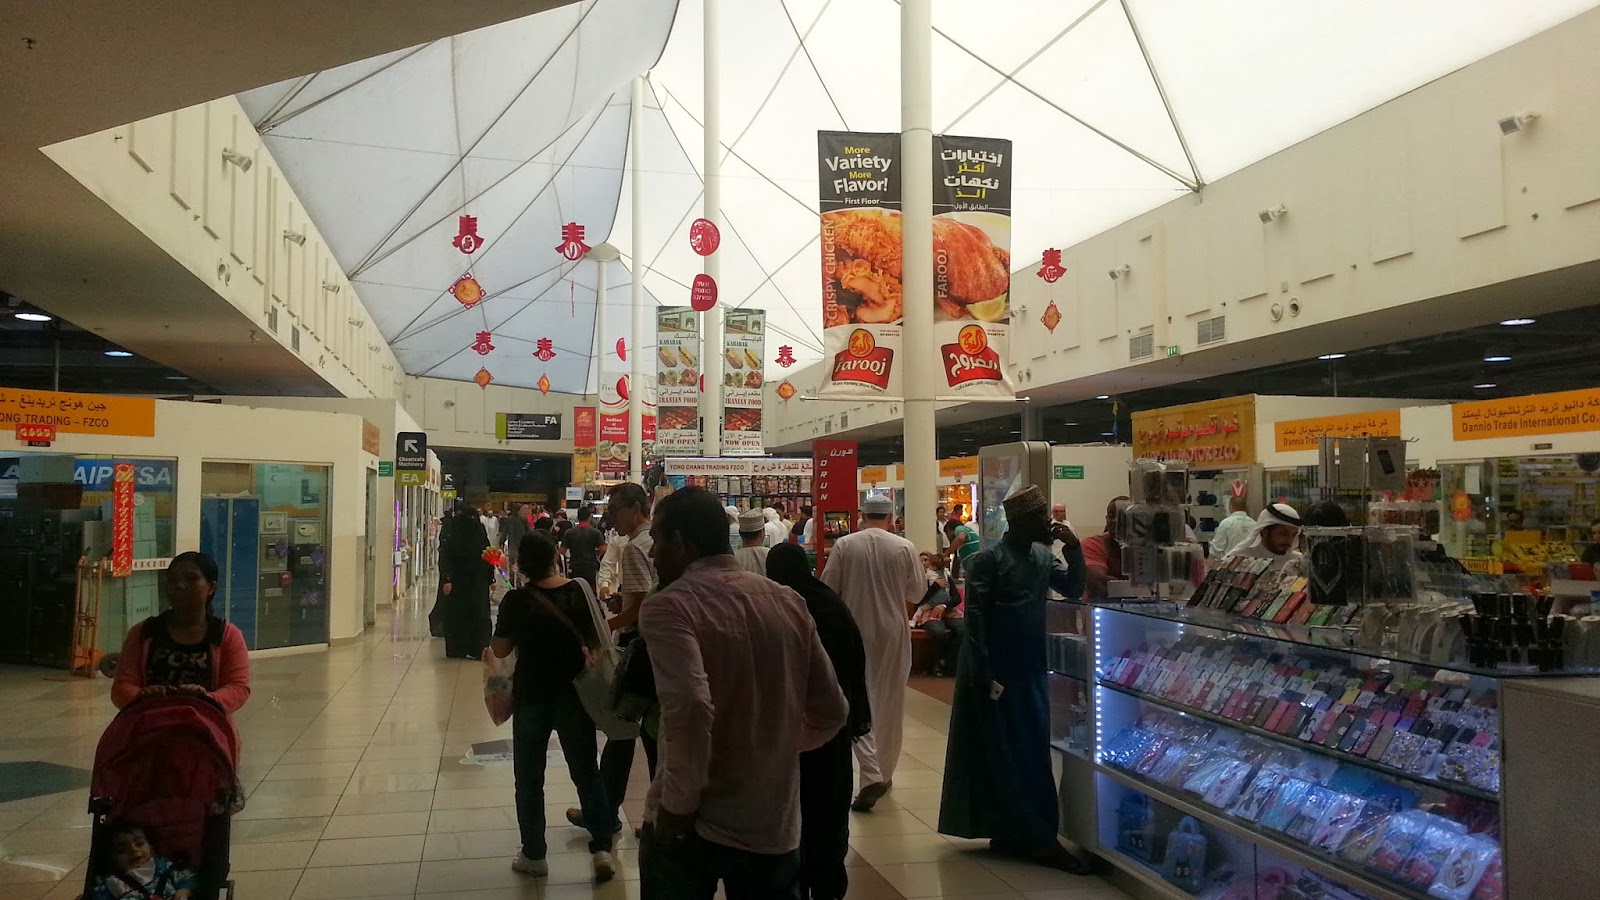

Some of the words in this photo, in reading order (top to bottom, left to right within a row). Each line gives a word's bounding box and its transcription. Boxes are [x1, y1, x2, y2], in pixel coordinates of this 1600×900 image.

[825, 154, 892, 173] Variety
[941, 149, 1003, 168] إختيارات
[849, 171, 872, 179] More
[944, 175, 999, 189] نكهات
[834, 177, 888, 194] Flavor!
[845, 197, 860, 205] First
[969, 203, 988, 211] الطابق
[824, 220, 836, 275] CHICKEN
[937, 249, 948, 298] FAROOJ
[826, 277, 837, 321] CRISPY
[25, 414, 71, 426] TRADING
[83, 418, 109, 427] FZCO
[545, 416, 557, 424] FA
[1463, 420, 1492, 433] Dannio
[1494, 418, 1518, 431] Trade
[1520, 413, 1580, 428] International
[1283, 437, 1305, 446] Dannio
[402, 474, 420, 483] EA
